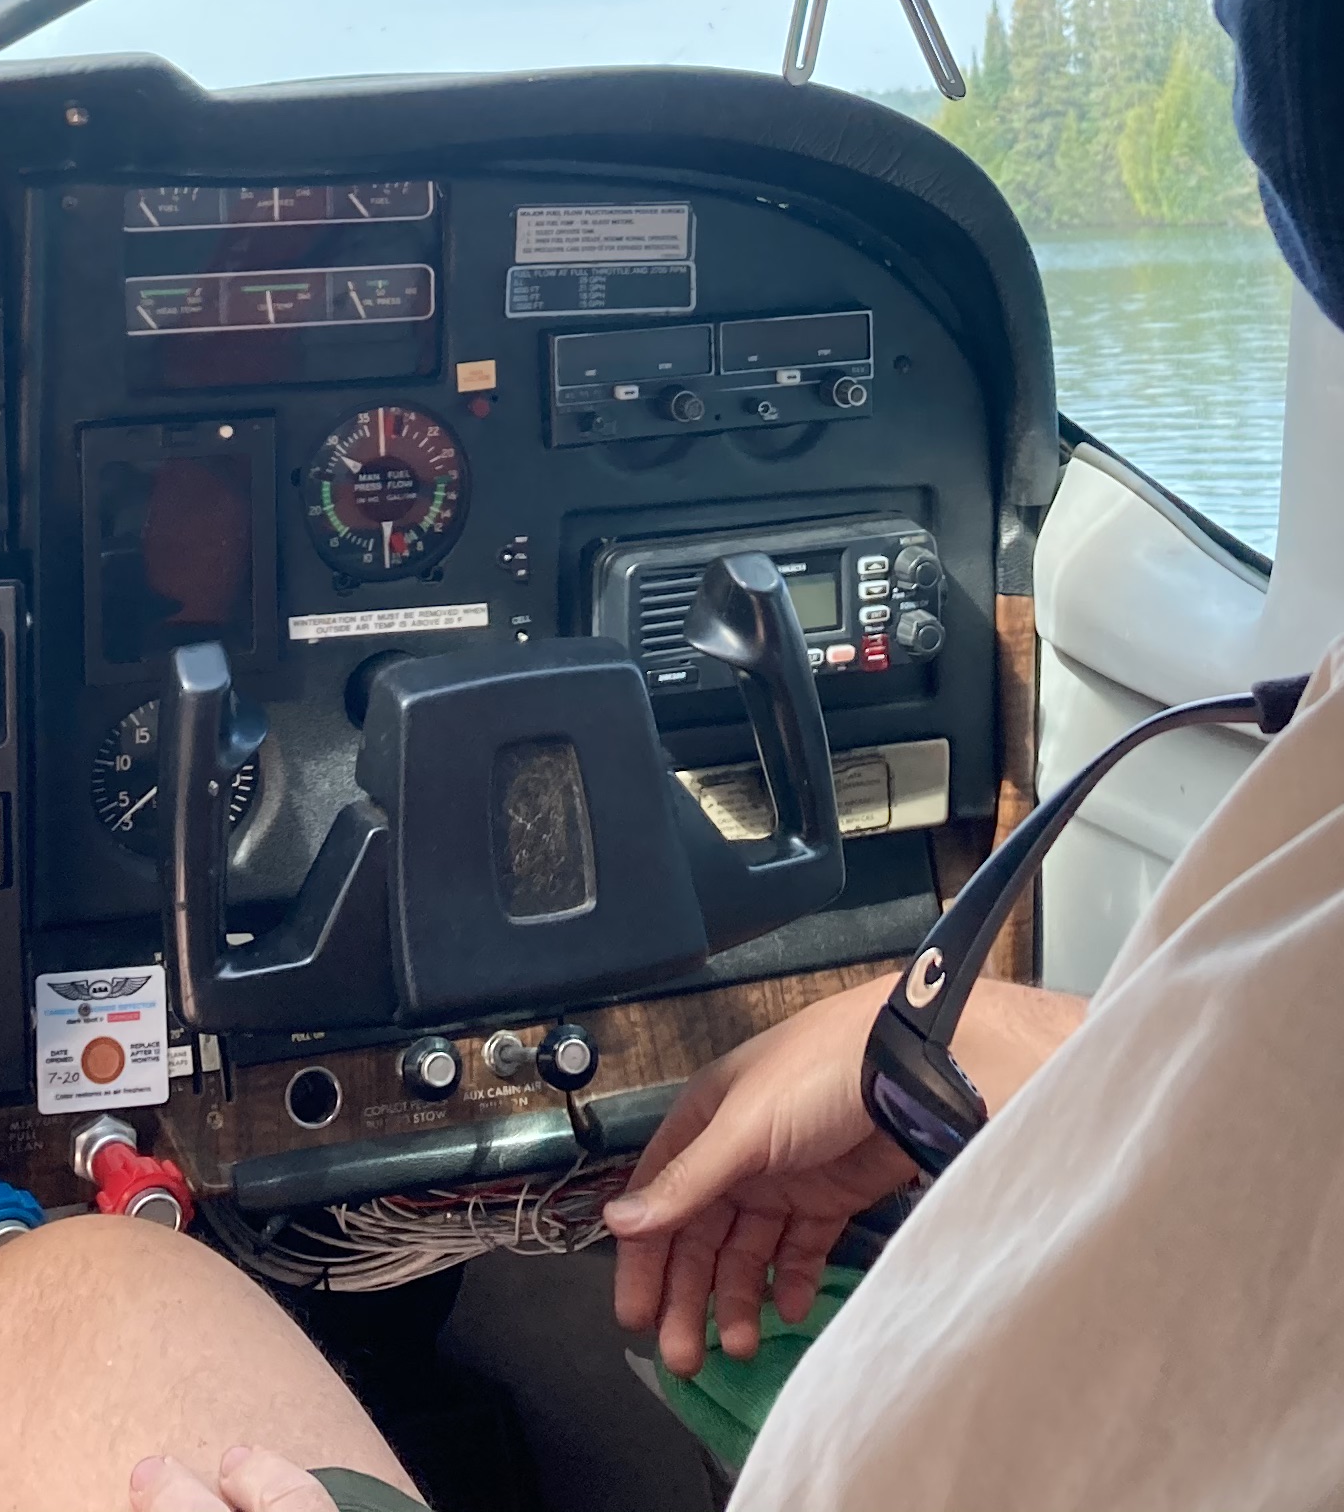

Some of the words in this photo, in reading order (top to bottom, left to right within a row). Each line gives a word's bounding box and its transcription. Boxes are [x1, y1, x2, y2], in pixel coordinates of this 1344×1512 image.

[369, 197, 391, 206] FUEL
[513, 269, 532, 279] FUEL
[533, 269, 556, 278] FLOW
[557, 268, 568, 277] AT
[570, 268, 589, 277] FULL
[591, 267, 631, 276] THROTTLE
[631, 266, 649, 275] AND
[669, 266, 688, 274] RPM
[387, 470, 410, 479] FUEL
[387, 480, 413, 489] FLOW
[292, 614, 357, 628] WINTERIZATION
[359, 614, 374, 623] KIT
[376, 612, 401, 622] MUST
[403, 611, 415, 620] BE
[418, 608, 460, 618] REMOVED
[462, 606, 487, 616] WHEN
[315, 623, 351, 635] OUTSIDE
[355, 622, 370, 632] AIR
[373, 621, 396, 631] TEMP
[410, 617, 441, 628] ABOVE
[135, 727, 151, 744] 15
[115, 755, 132, 772] 10
[118, 791, 130, 807] 5
[130, 1041, 161, 1050] REPLACE
[50, 1049, 68, 1057] DATE
[130, 1049, 152, 1058] AFTER
[131, 1056, 161, 1064] MONTHS
[48, 1071, 81, 1085] 7-20
[462, 1090, 486, 1102] AUX
[486, 1085, 522, 1100] CABIN
[412, 1110, 448, 1125] STOW
